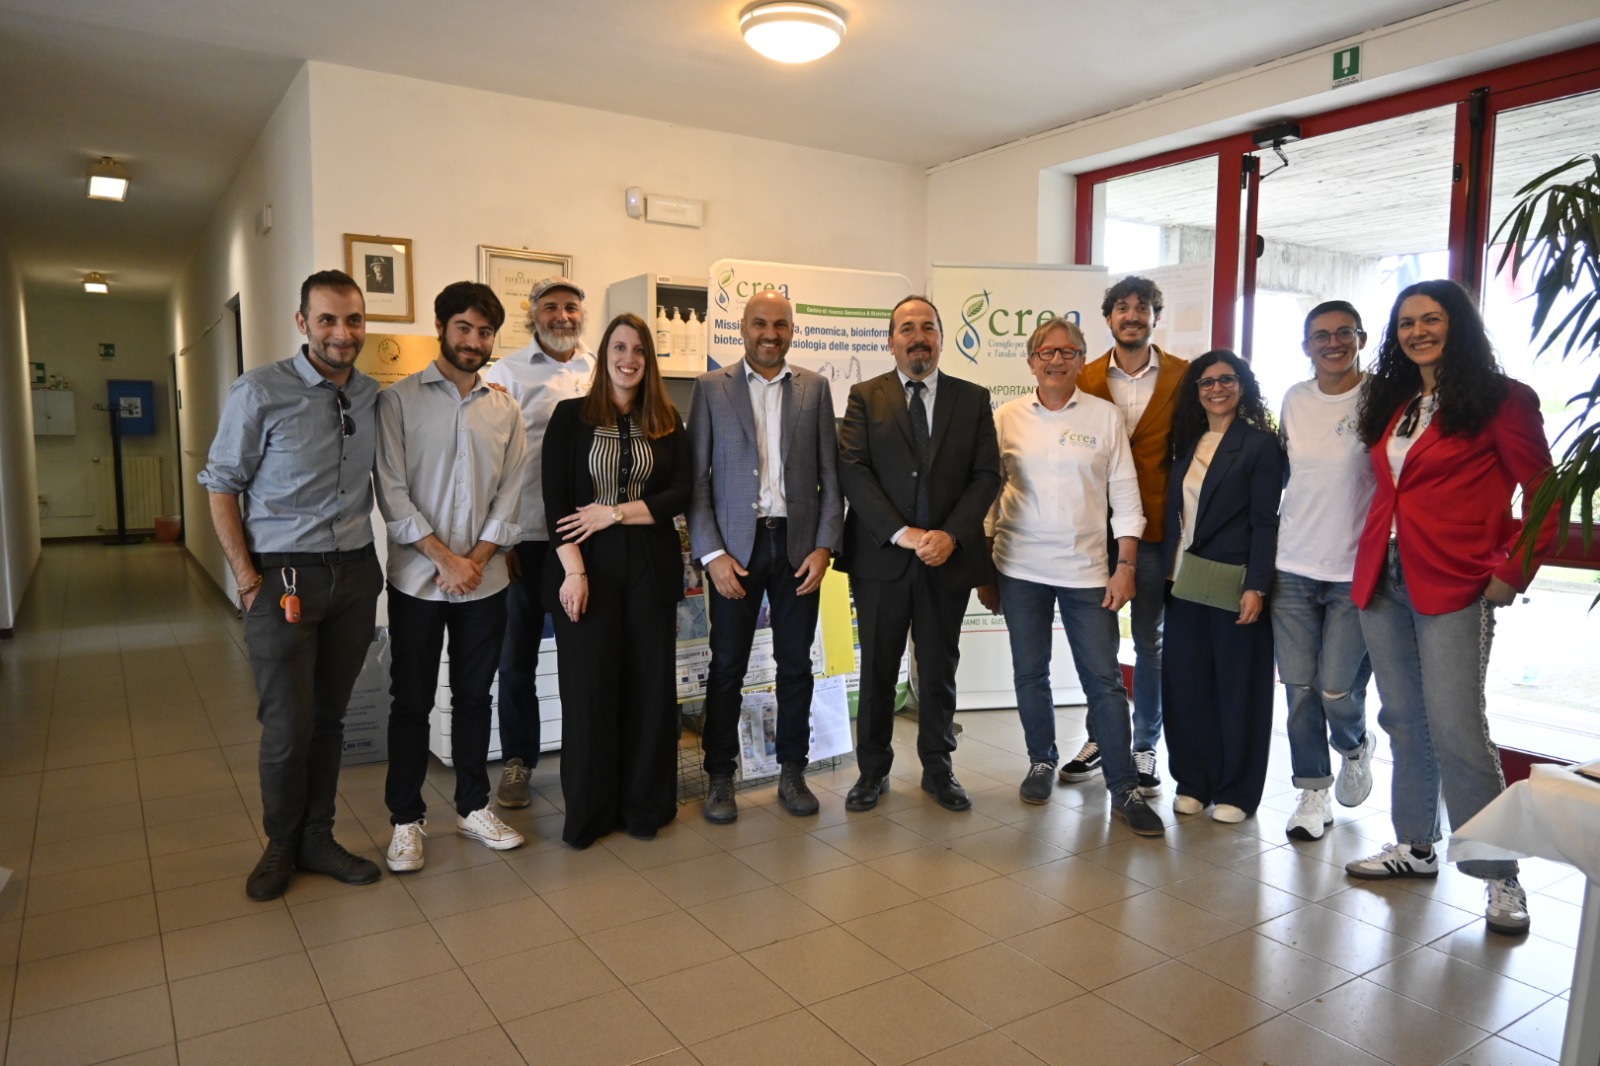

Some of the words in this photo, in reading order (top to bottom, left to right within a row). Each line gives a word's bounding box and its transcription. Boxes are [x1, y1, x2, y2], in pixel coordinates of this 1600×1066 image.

[715, 319, 741, 330] Missi
[804, 326, 849, 338] genomica,
[829, 340, 849, 351] delle
[851, 342, 878, 352] specie
[1015, 342, 1024, 350] per
[987, 385, 1037, 396] MPORTAN
[1069, 433, 1097, 445] crea
[991, 617, 1006, 625] GUS
